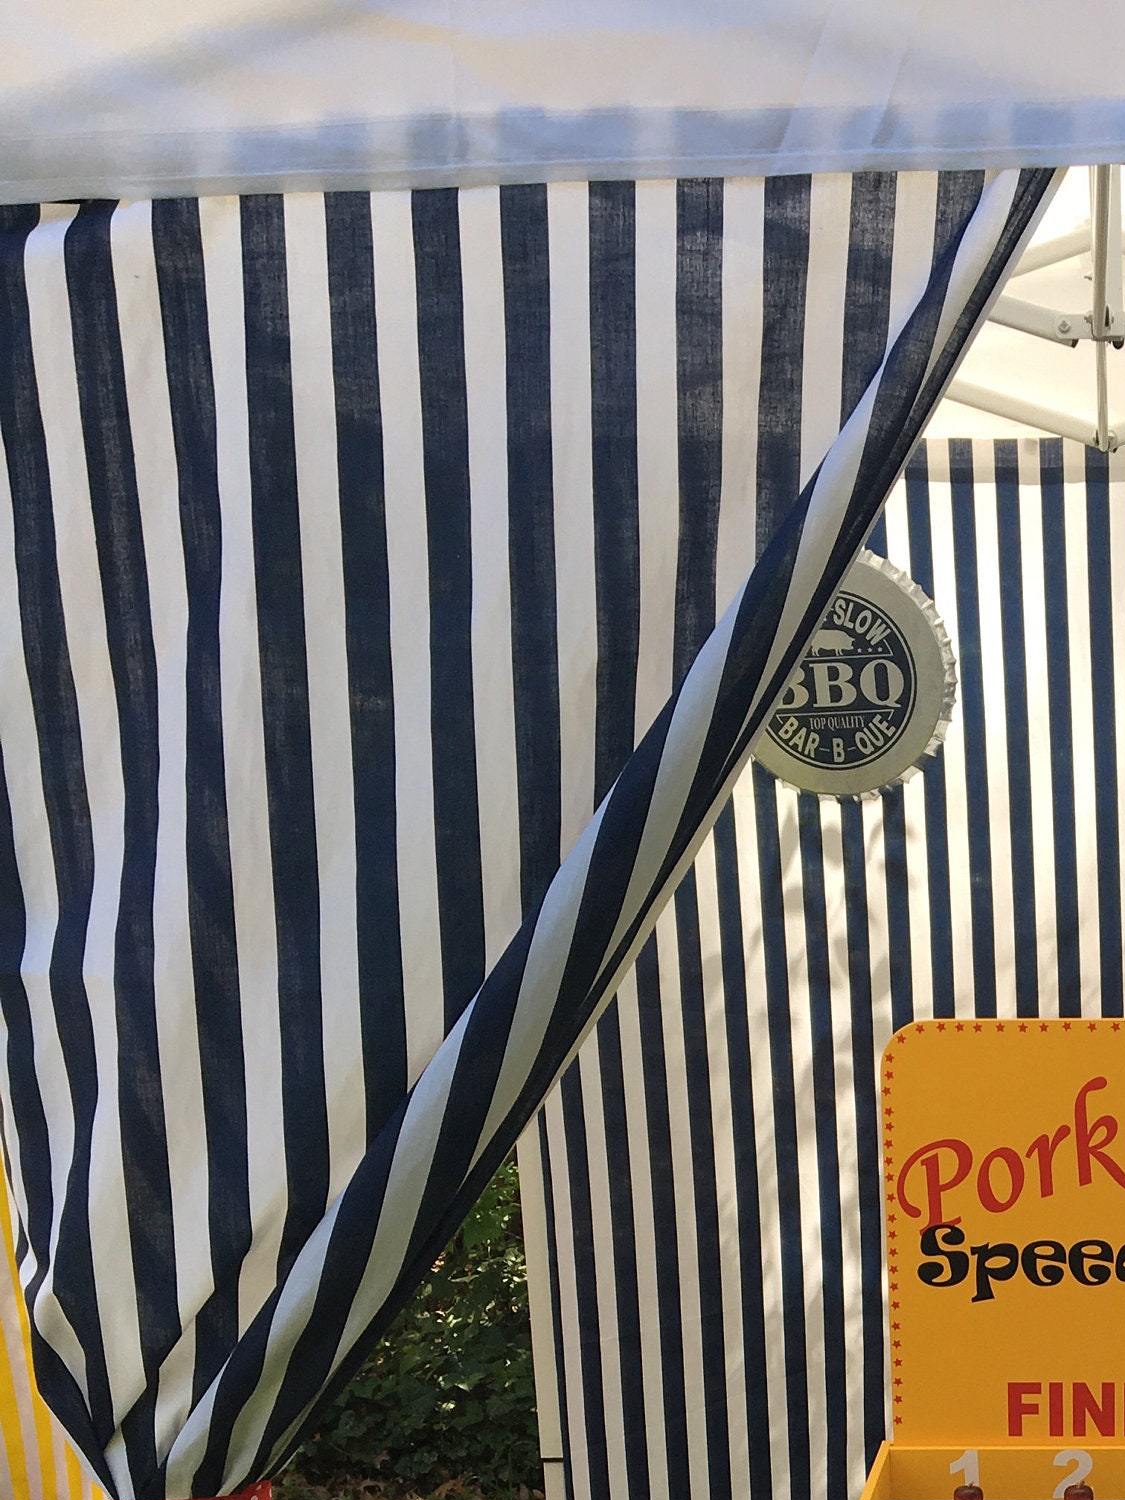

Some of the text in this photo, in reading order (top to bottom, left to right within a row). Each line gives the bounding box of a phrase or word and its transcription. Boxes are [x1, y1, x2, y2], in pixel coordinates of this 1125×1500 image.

[833, 598, 891, 645] SLOW
[809, 715, 865, 731] TOP QUALITY
[949, 1449, 980, 1488] 1
[1052, 1449, 1094, 1499] 2
